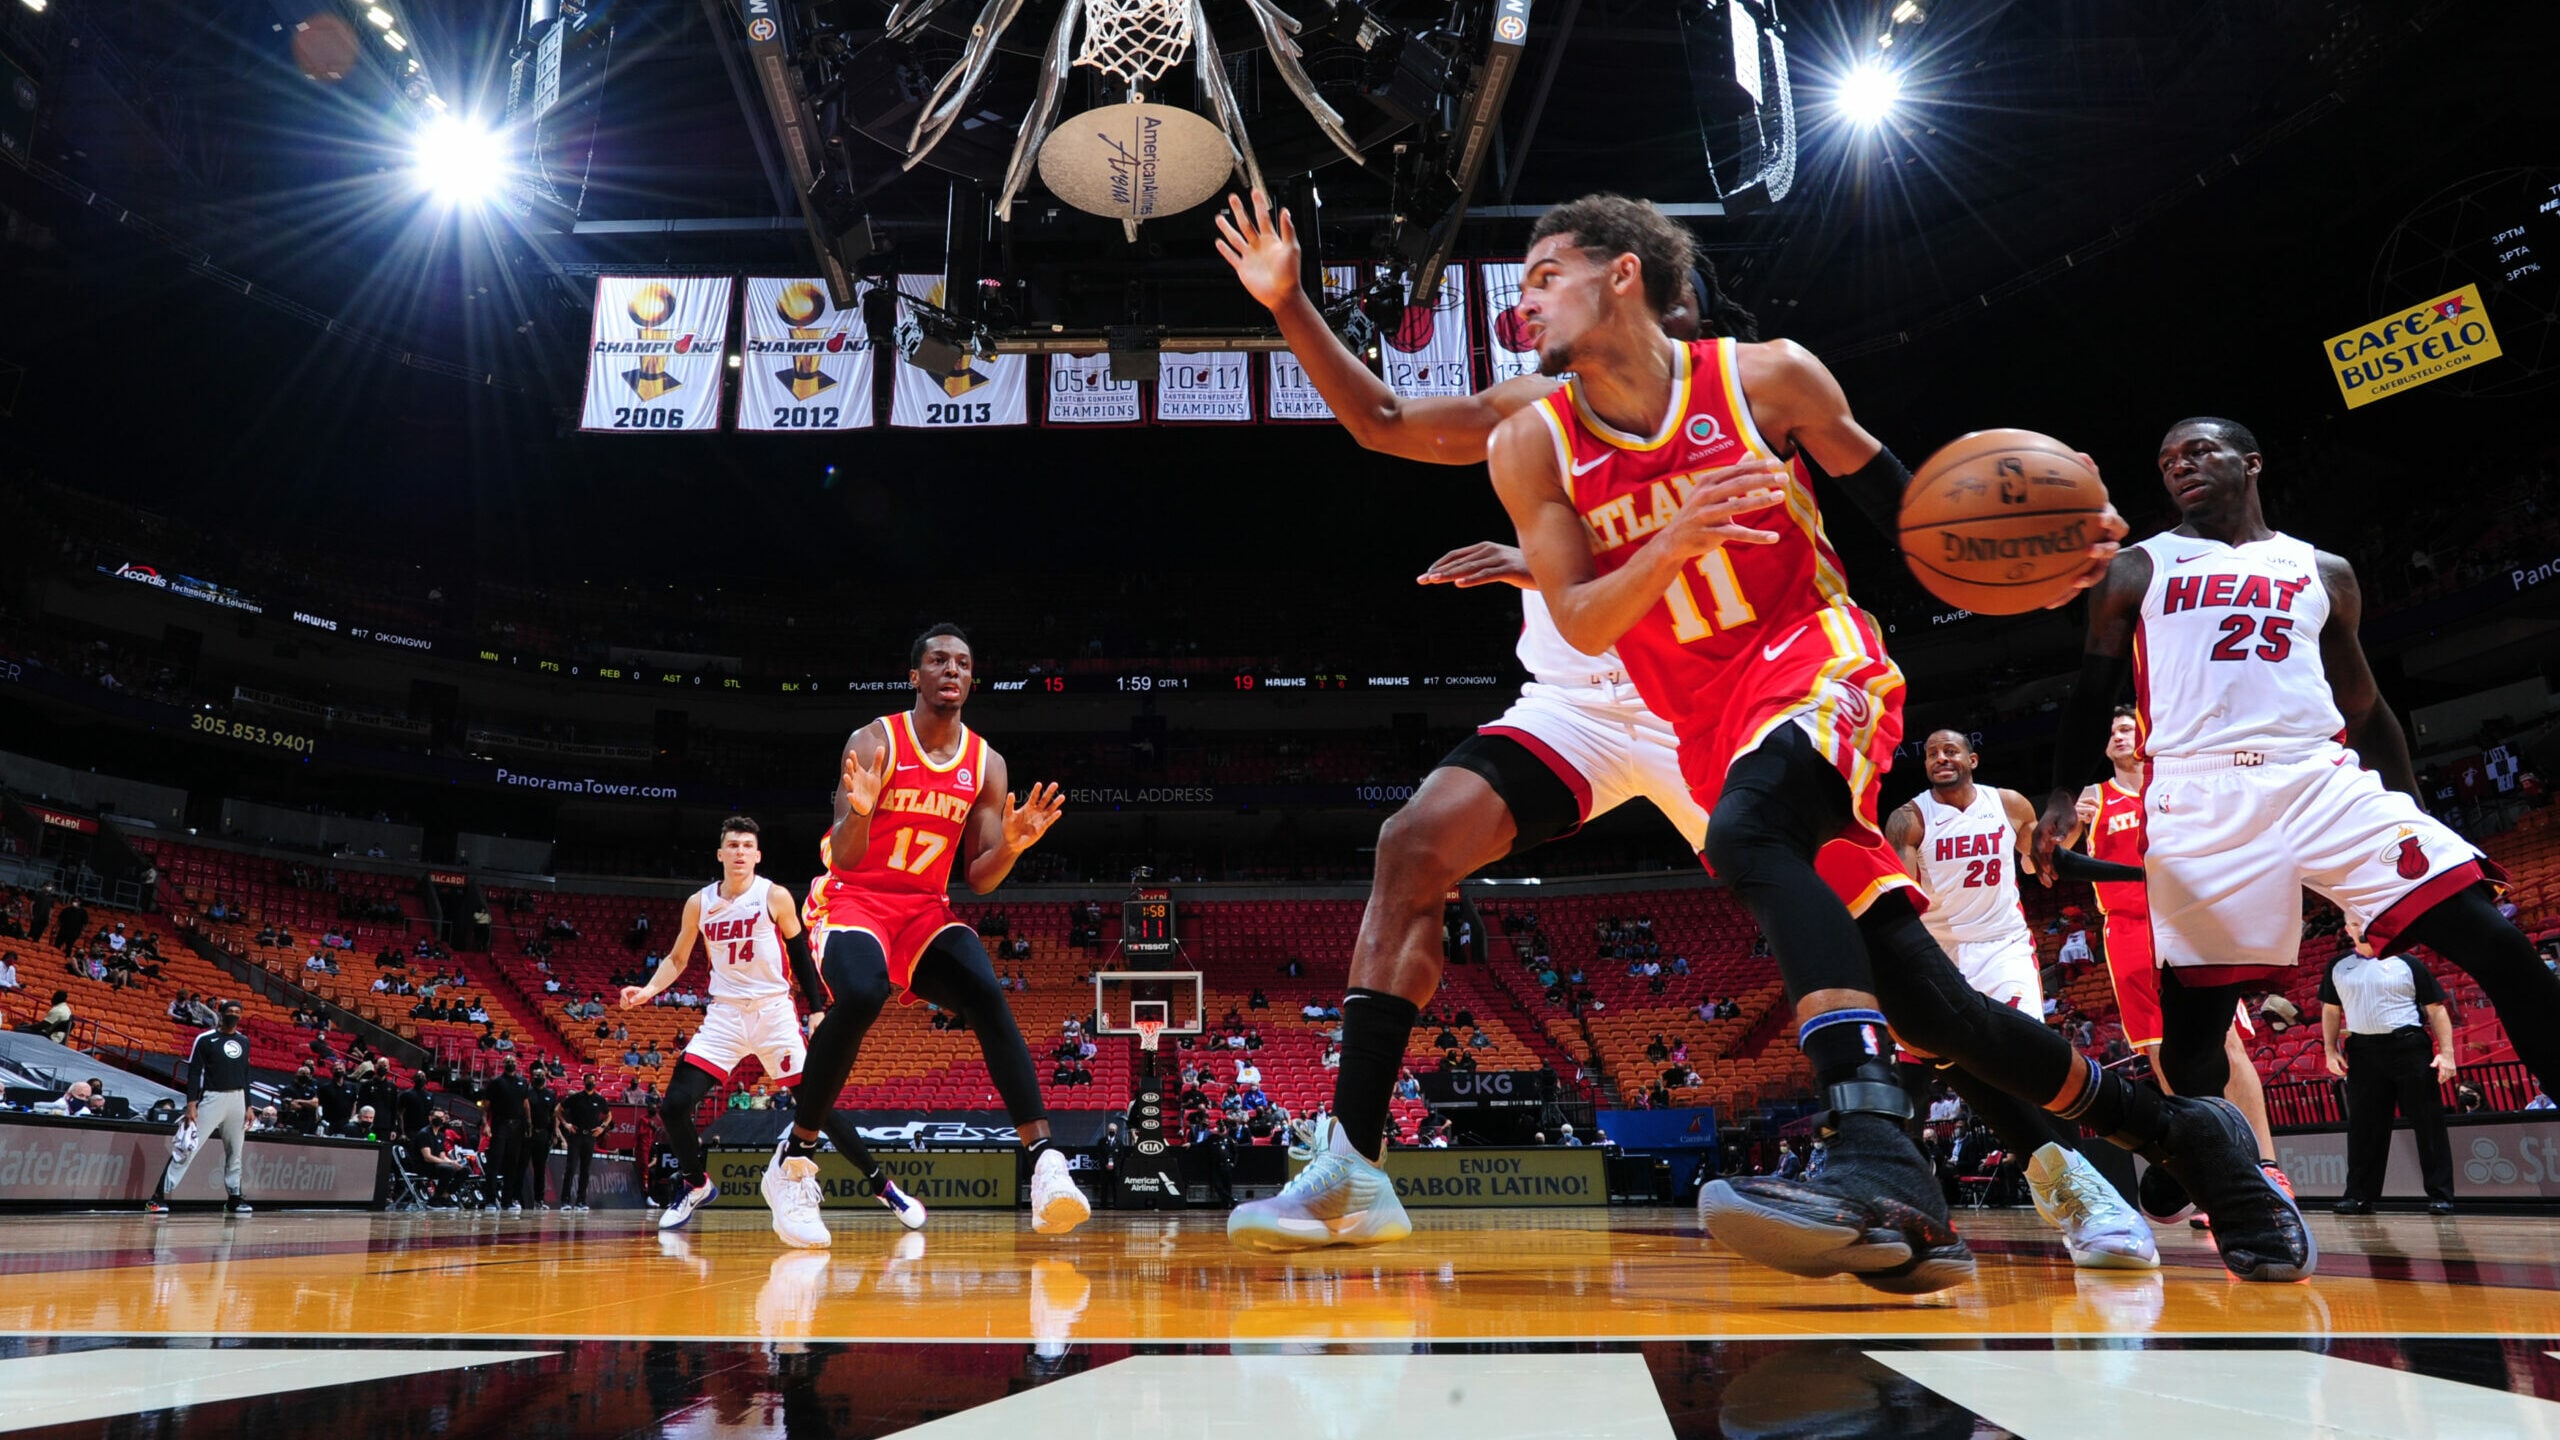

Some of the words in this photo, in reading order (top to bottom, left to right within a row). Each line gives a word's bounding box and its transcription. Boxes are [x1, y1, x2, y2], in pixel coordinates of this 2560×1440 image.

[2491, 226, 2526, 245] 3PTM
[2499, 246, 2530, 263] 3PTA
[2506, 263, 2540, 281] 3PT%
[2334, 308, 2430, 362] CAFÉ
[2341, 321, 2487, 390] BUSTELO
[1055, 369, 1083, 392] 05
[1166, 366, 1194, 389] 10
[1217, 366, 1241, 389] 11
[1387, 363, 1412, 386] 12
[1437, 363, 1463, 386] 13
[2371, 354, 2472, 395] CAFEBUSTELO.COM
[614, 407, 684, 428] 2006
[773, 407, 839, 428] 2012
[926, 403, 991, 424] 2013
[1054, 405, 1134, 416] CHAMPIONS
[1163, 403, 1244, 414] CHAMPIONS
[1276, 402, 1330, 413] CHAMPI
[1940, 519, 2087, 562] SPALDING
[115, 562, 167, 588] Acordis
[171, 583, 216, 603] Technology
[226, 596, 262, 613] Solutions
[1663, 545, 1757, 645] 11
[2163, 574, 2311, 615] HEAT
[1932, 608, 1973, 626] PLAYER
[293, 611, 337, 631] HAWKS
[351, 628, 369, 639] #17
[375, 632, 432, 650] OKONGWU
[2210, 614, 2293, 662] 25
[480, 651, 499, 662] MIN
[540, 661, 559, 673] PTS
[572, 667, 578, 675] 0
[600, 669, 620, 679] REB
[634, 672, 640, 680] 0
[663, 674, 681, 684] AST
[694, 677, 700, 685] 0
[724, 679, 741, 688] STL
[782, 682, 800, 691] BLK
[812, 682, 818, 691] 0
[849, 681, 884, 691] PLAYER
[886, 681, 914, 691] STATS
[993, 679, 1028, 690] HEAT
[1044, 677, 1064, 691] 15
[1117, 676, 1151, 691] 1:59
[1158, 680, 1178, 689] QTR
[1182, 679, 1188, 688] 1
[1233, 675, 1254, 690] 19
[1265, 678, 1306, 687] HAWKS
[1368, 677, 1410, 686] HAWKS
[1424, 677, 1439, 685] #17
[1445, 676, 1496, 685] OKONGWU
[191, 714, 315, 753] 305.853.9401
[497, 768, 677, 799] PanoramaTower.com
[1070, 789, 1133, 802] RENTAL
[1137, 788, 1214, 802] ADDRESS
[2107, 811, 2140, 835] ATL
[887, 827, 948, 876] 17
[1936, 824, 2005, 861] HEAT
[1963, 859, 2002, 888] 28
[1143, 905, 1166, 918] 1:58
[704, 911, 761, 941] HEAT
[1142, 919, 1164, 938] 11
[728, 940, 754, 964] 14
[1141, 1141, 1160, 1152] KIA
[244, 1152, 336, 1190] StateFarm
[1460, 1159, 1521, 1174] ENJOY
[904, 1179, 999, 1198] LATINO!
[1131, 1184, 1159, 1192] Airlines
[1395, 1176, 1481, 1197] SABOR
[1491, 1176, 1589, 1196] LATINO!
